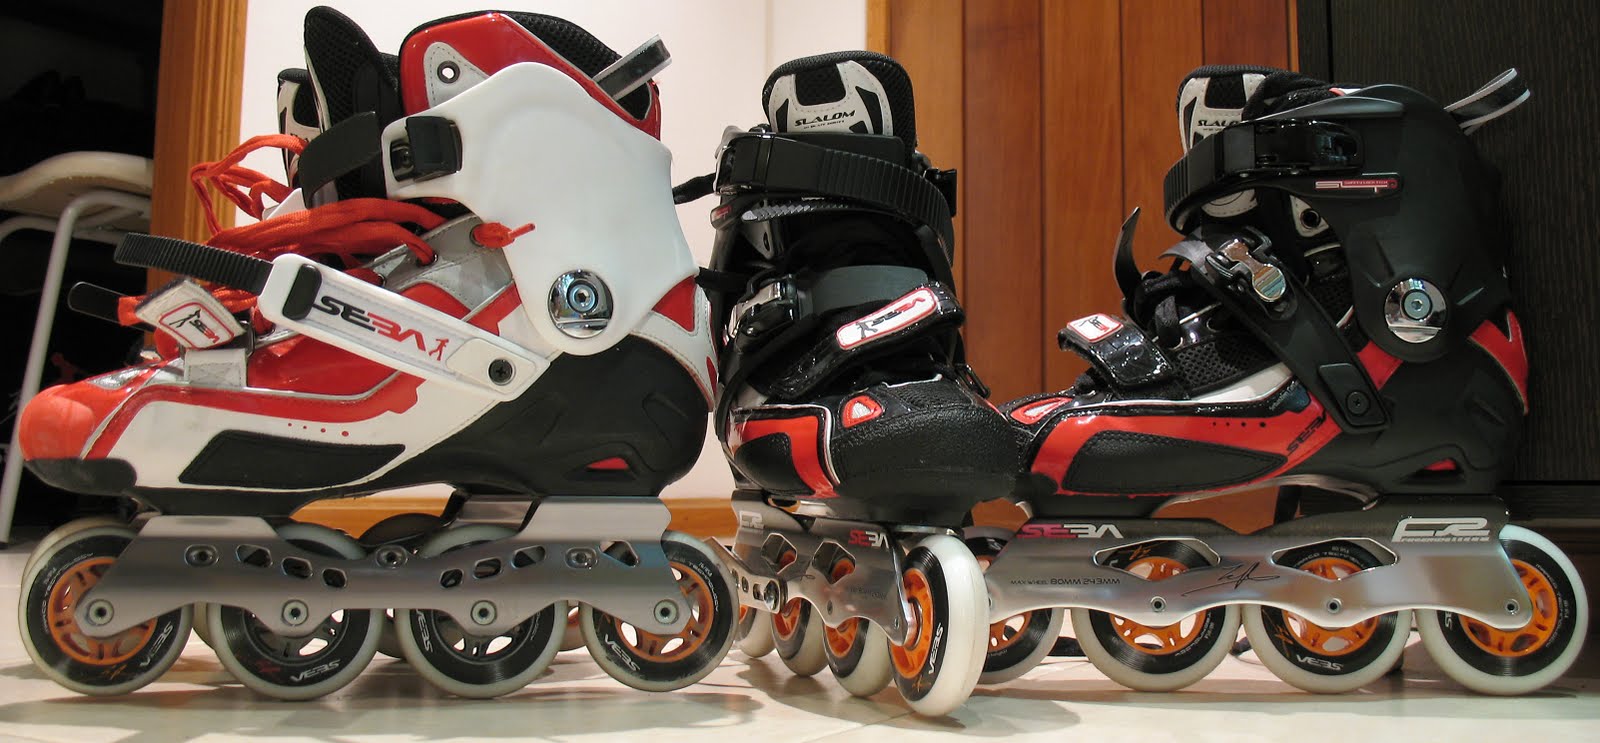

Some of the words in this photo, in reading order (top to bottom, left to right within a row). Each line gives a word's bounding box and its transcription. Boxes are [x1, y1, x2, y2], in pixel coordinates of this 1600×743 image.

[795, 110, 855, 127] SLALOM
[311, 295, 426, 352] SEBA
[872, 297, 926, 327] SEBA
[189, 319, 220, 344] SEBA
[848, 529, 890, 549] SEBA
[1016, 523, 1124, 539] SEBA
[140, 620, 174, 667] SEBA
[416, 609, 433, 653] SEBA
[604, 633, 641, 672] SEBA
[928, 622, 944, 675] SEBA
[290, 658, 341, 682] SEBA
[1296, 654, 1344, 671] SEBA
